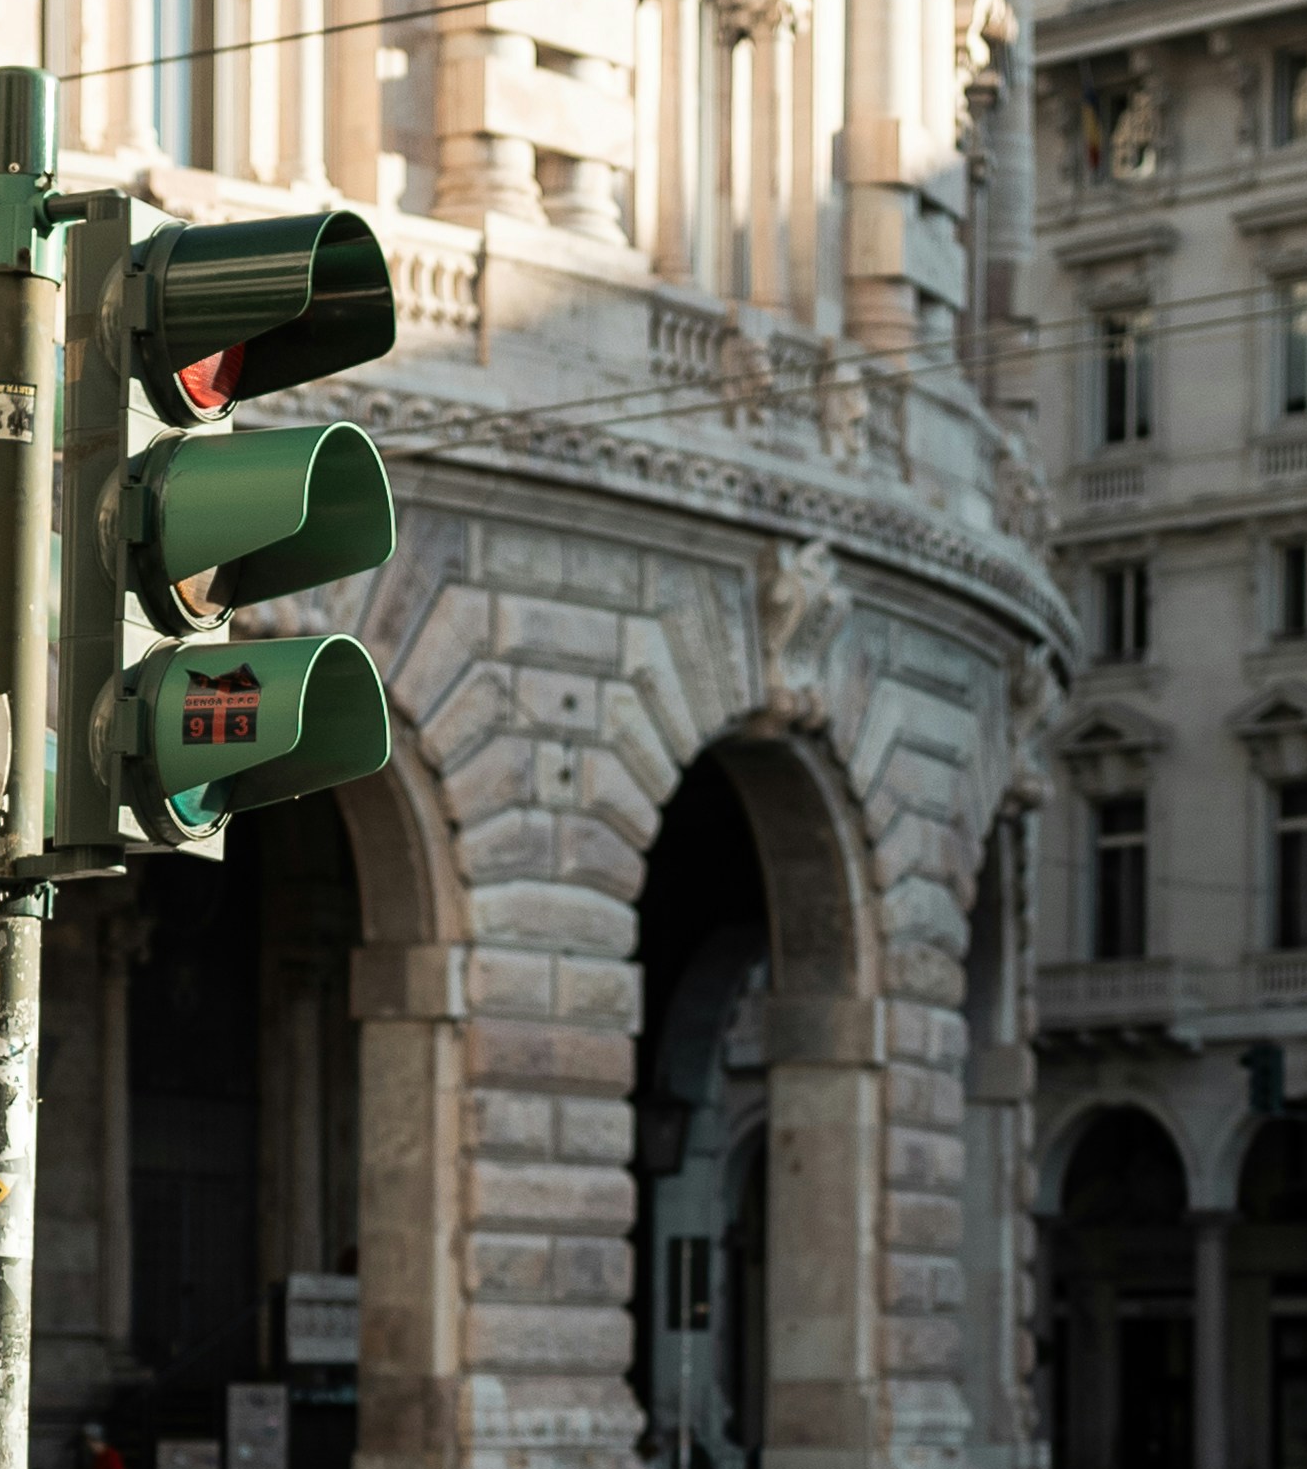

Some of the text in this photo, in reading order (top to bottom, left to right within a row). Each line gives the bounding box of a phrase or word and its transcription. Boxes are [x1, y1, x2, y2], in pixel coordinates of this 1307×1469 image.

[185, 697, 222, 707] GENOA
[190, 715, 249, 737] 9 3
